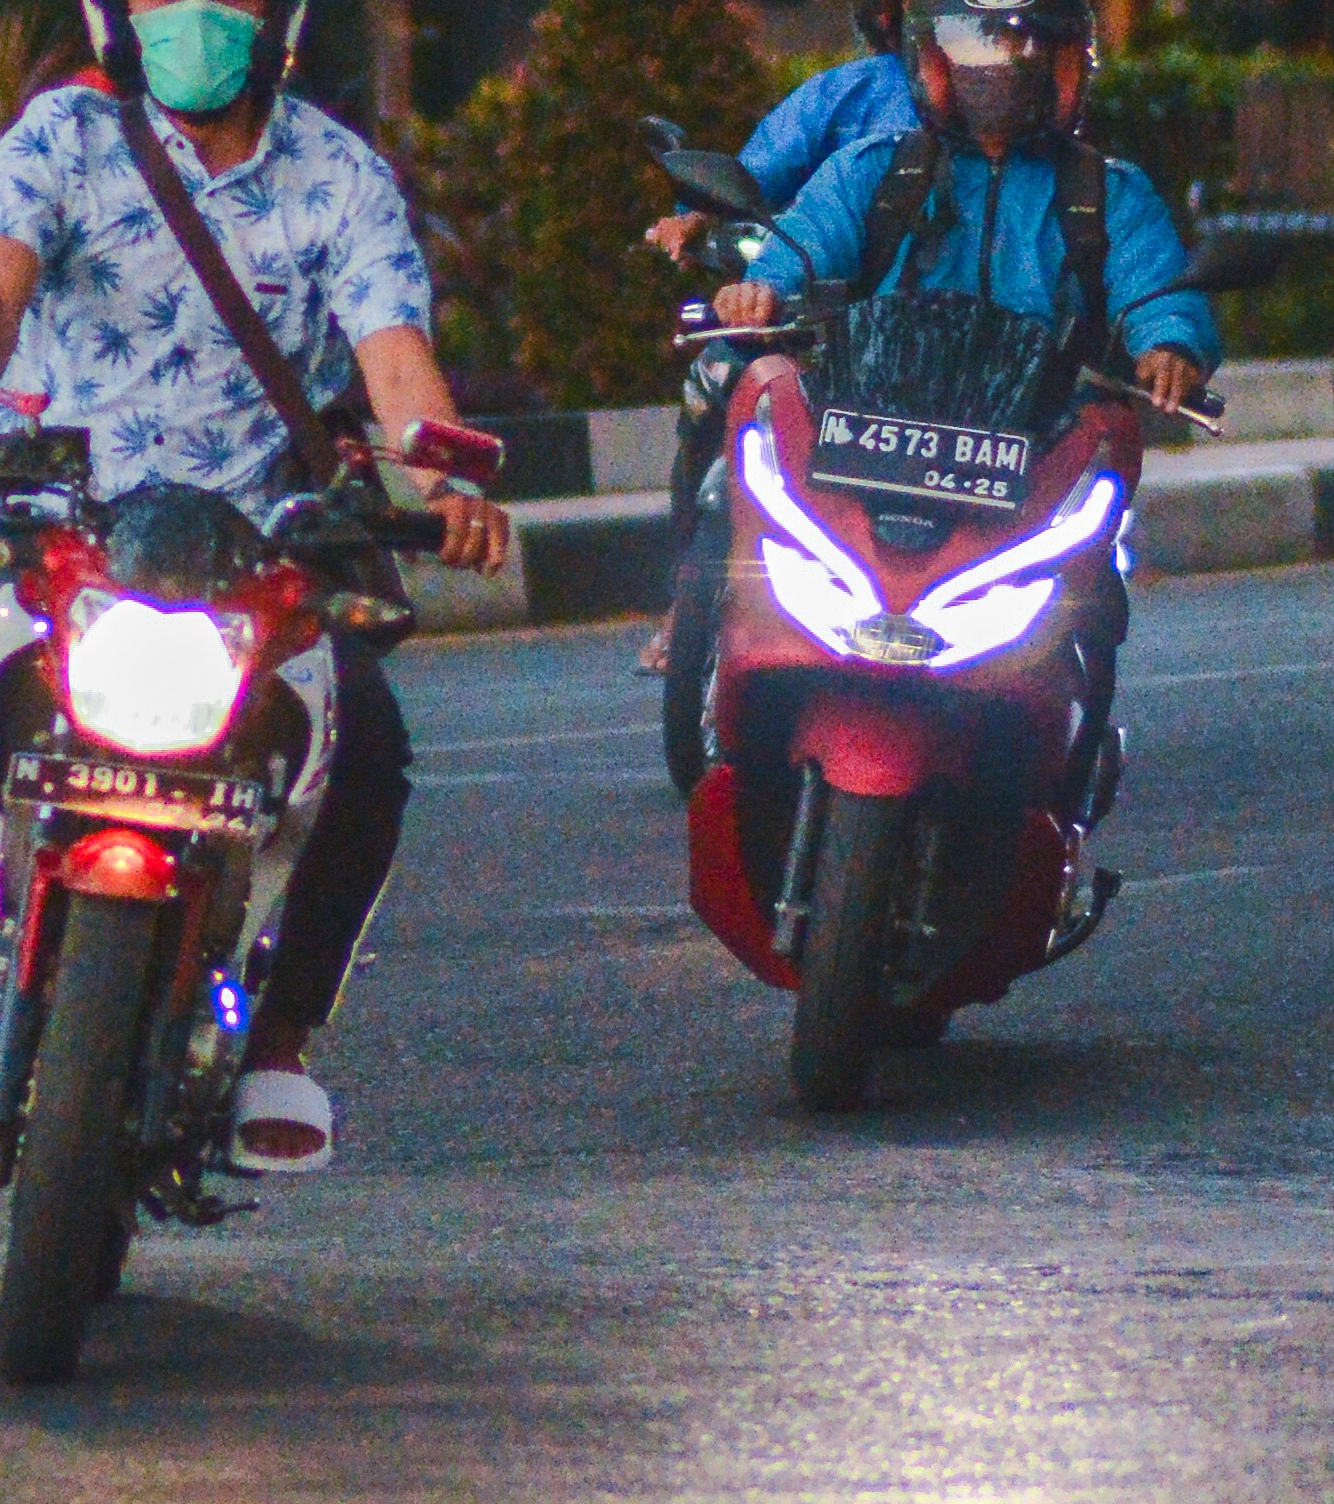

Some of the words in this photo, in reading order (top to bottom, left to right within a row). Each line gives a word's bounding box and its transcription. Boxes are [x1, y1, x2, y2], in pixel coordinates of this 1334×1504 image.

[825, 416, 852, 444] N
[859, 424, 939, 458] 4573
[955, 435, 1020, 471] BAM
